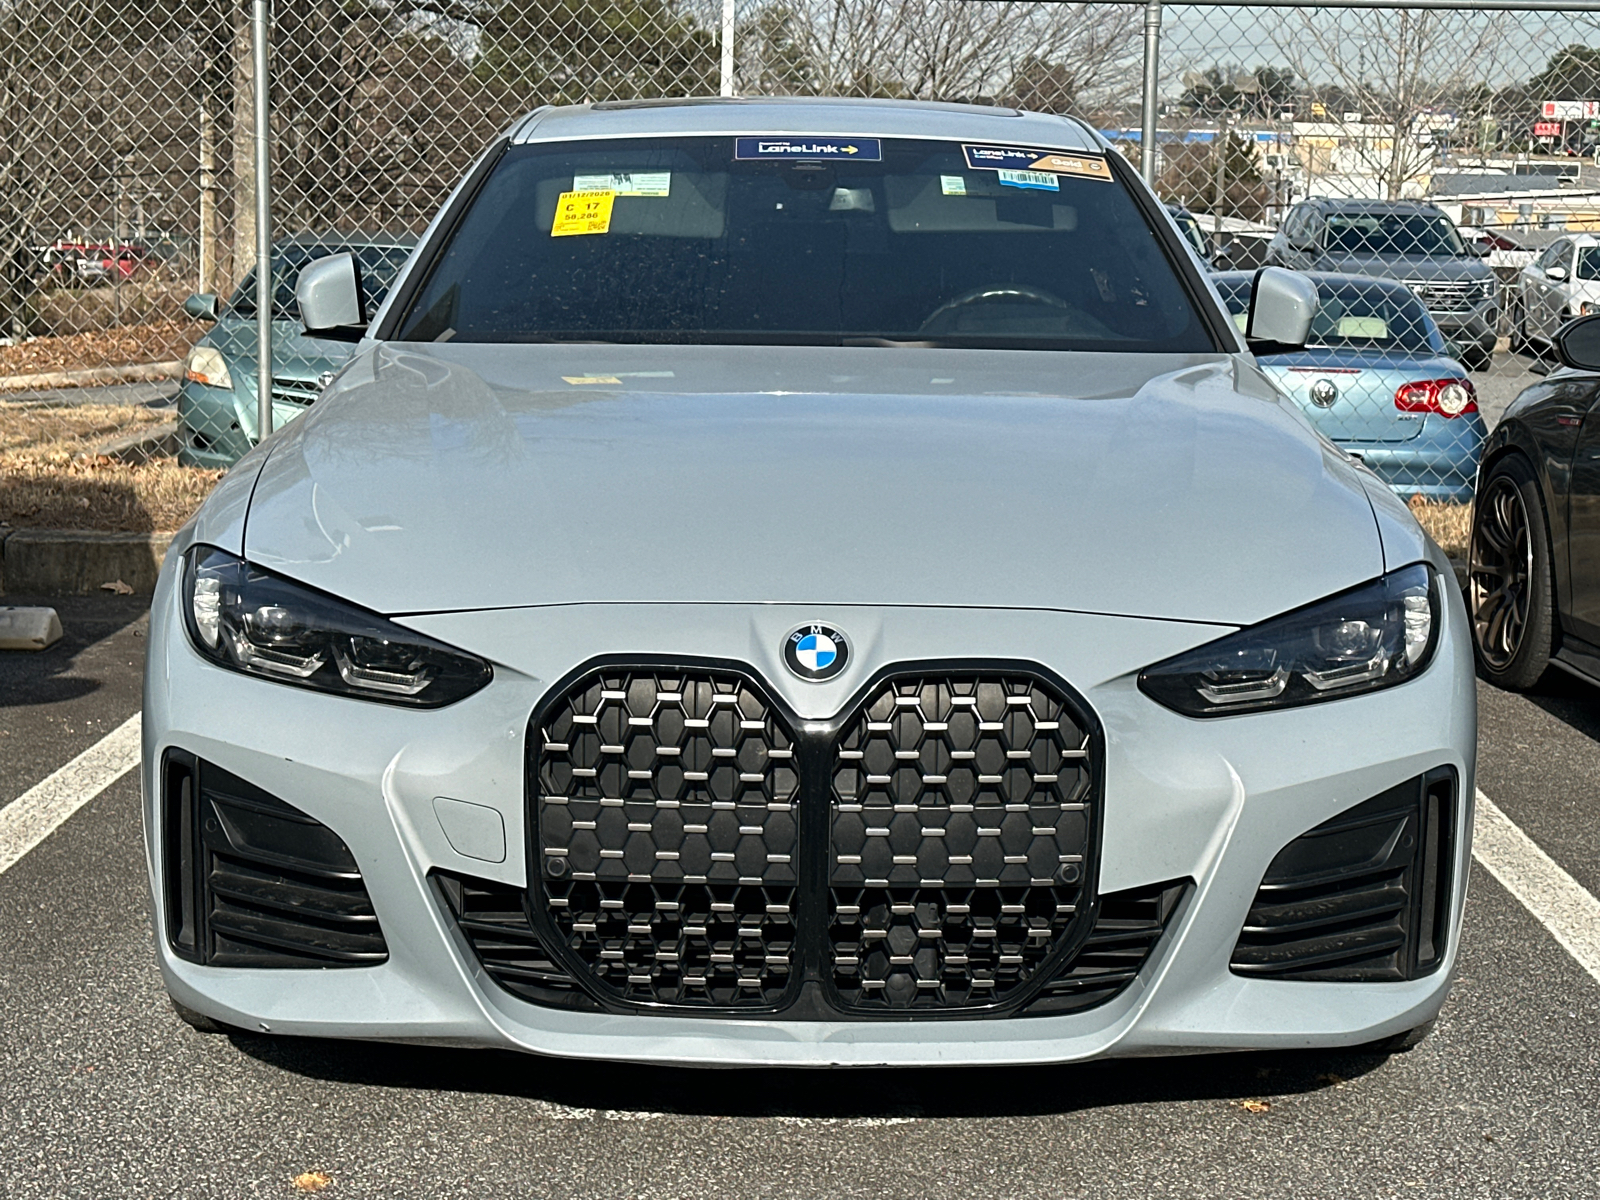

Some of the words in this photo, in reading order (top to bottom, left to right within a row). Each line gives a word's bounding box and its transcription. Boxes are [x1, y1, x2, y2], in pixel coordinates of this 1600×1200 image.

[758, 144, 839, 154] LaneLink
[973, 148, 1027, 158] LaneLink
[1051, 158, 1083, 168] Gold
[566, 203, 575, 212] C
[585, 202, 600, 210] 17
[790, 625, 844, 644] BMW
